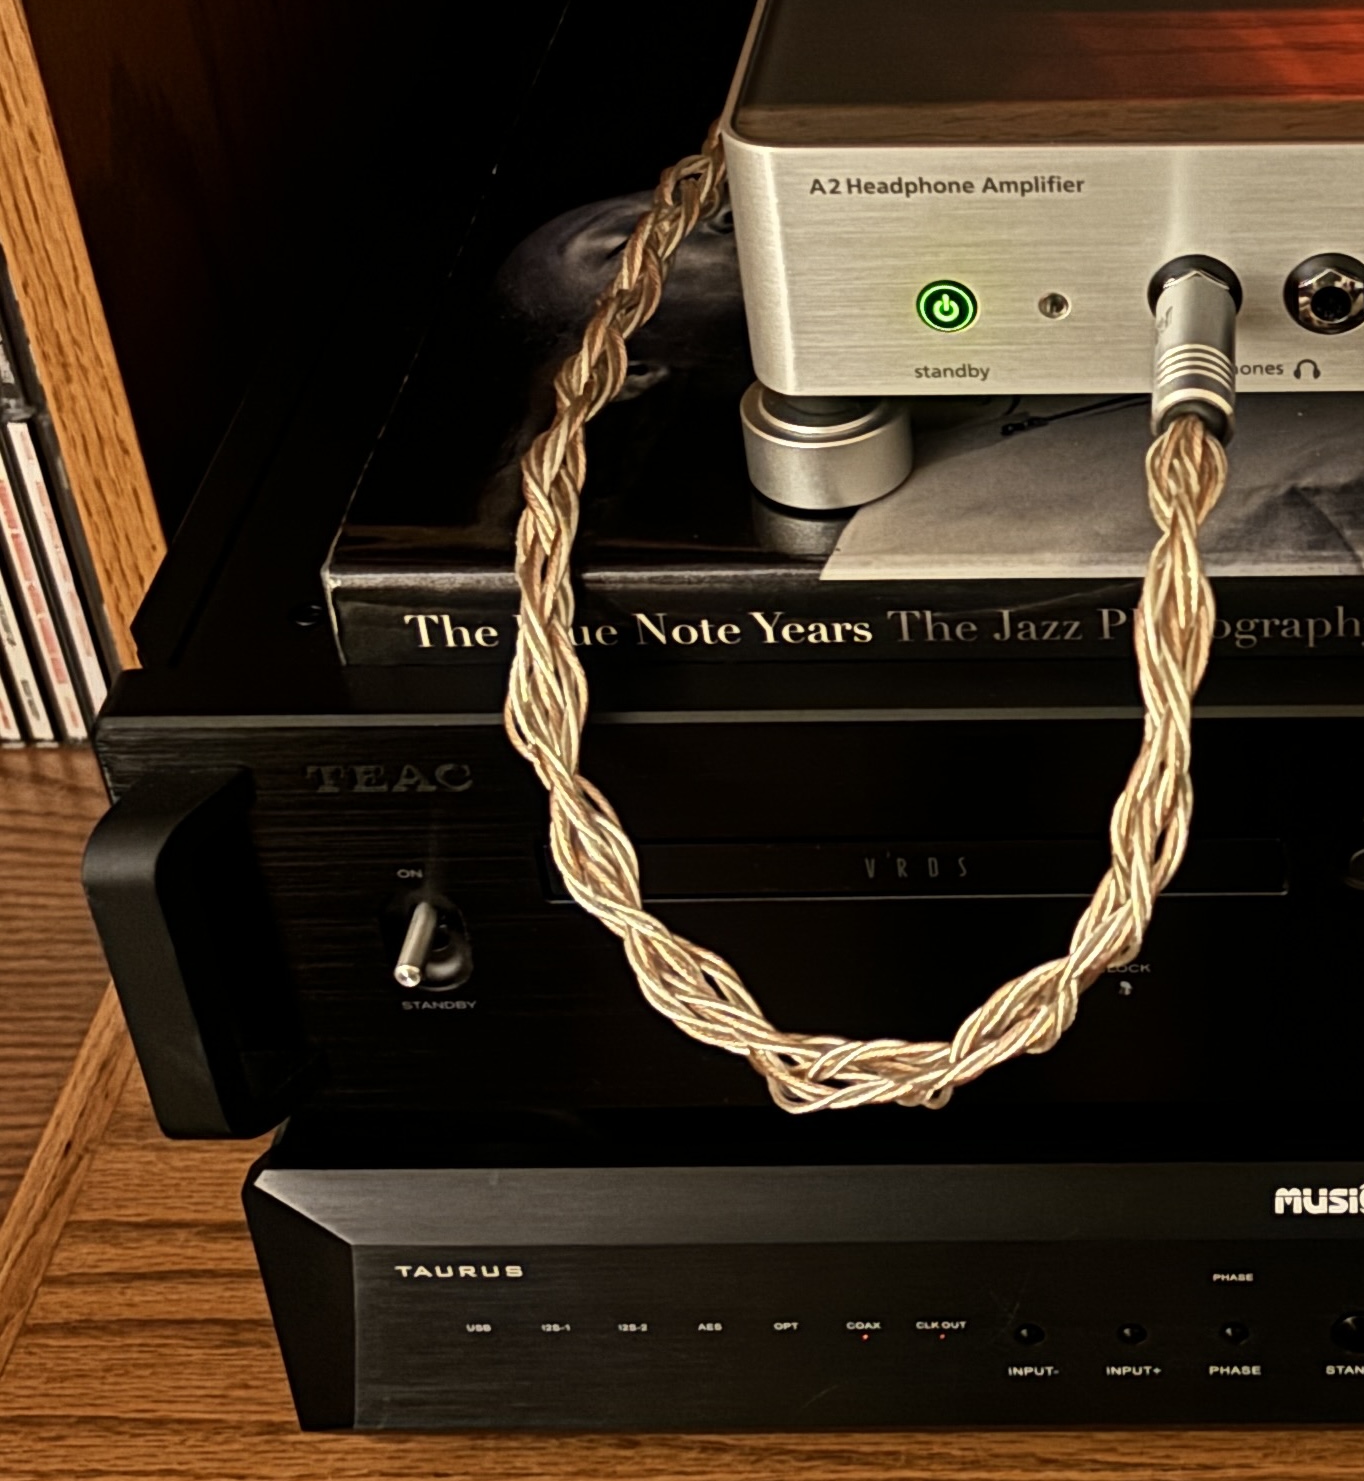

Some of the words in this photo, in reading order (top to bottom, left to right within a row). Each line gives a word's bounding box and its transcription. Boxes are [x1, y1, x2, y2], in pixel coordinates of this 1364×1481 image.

[846, 176, 975, 198] Headphone
[982, 175, 1085, 197] Amplifier
[914, 363, 990, 382] standby
[403, 613, 500, 648] The
[635, 612, 742, 645] Note
[747, 611, 873, 644] Years
[887, 610, 978, 643] The
[992, 610, 1083, 642] Jazz
[305, 763, 474, 793] TEAC
[396, 868, 423, 879] ON
[401, 999, 477, 1010] STANDBY
[394, 1265, 524, 1279] TAURUS
[1212, 1273, 1254, 1282] PHASE
[466, 1323, 492, 1333] USB
[698, 1322, 723, 1332] AES
[773, 1322, 798, 1331] OPT
[846, 1320, 882, 1330] COAX
[915, 1320, 940, 1330] CLK
[941, 1320, 967, 1330] OUT
[1106, 1365, 1162, 1377] INPUT+
[1208, 1364, 1262, 1376] PHASE
